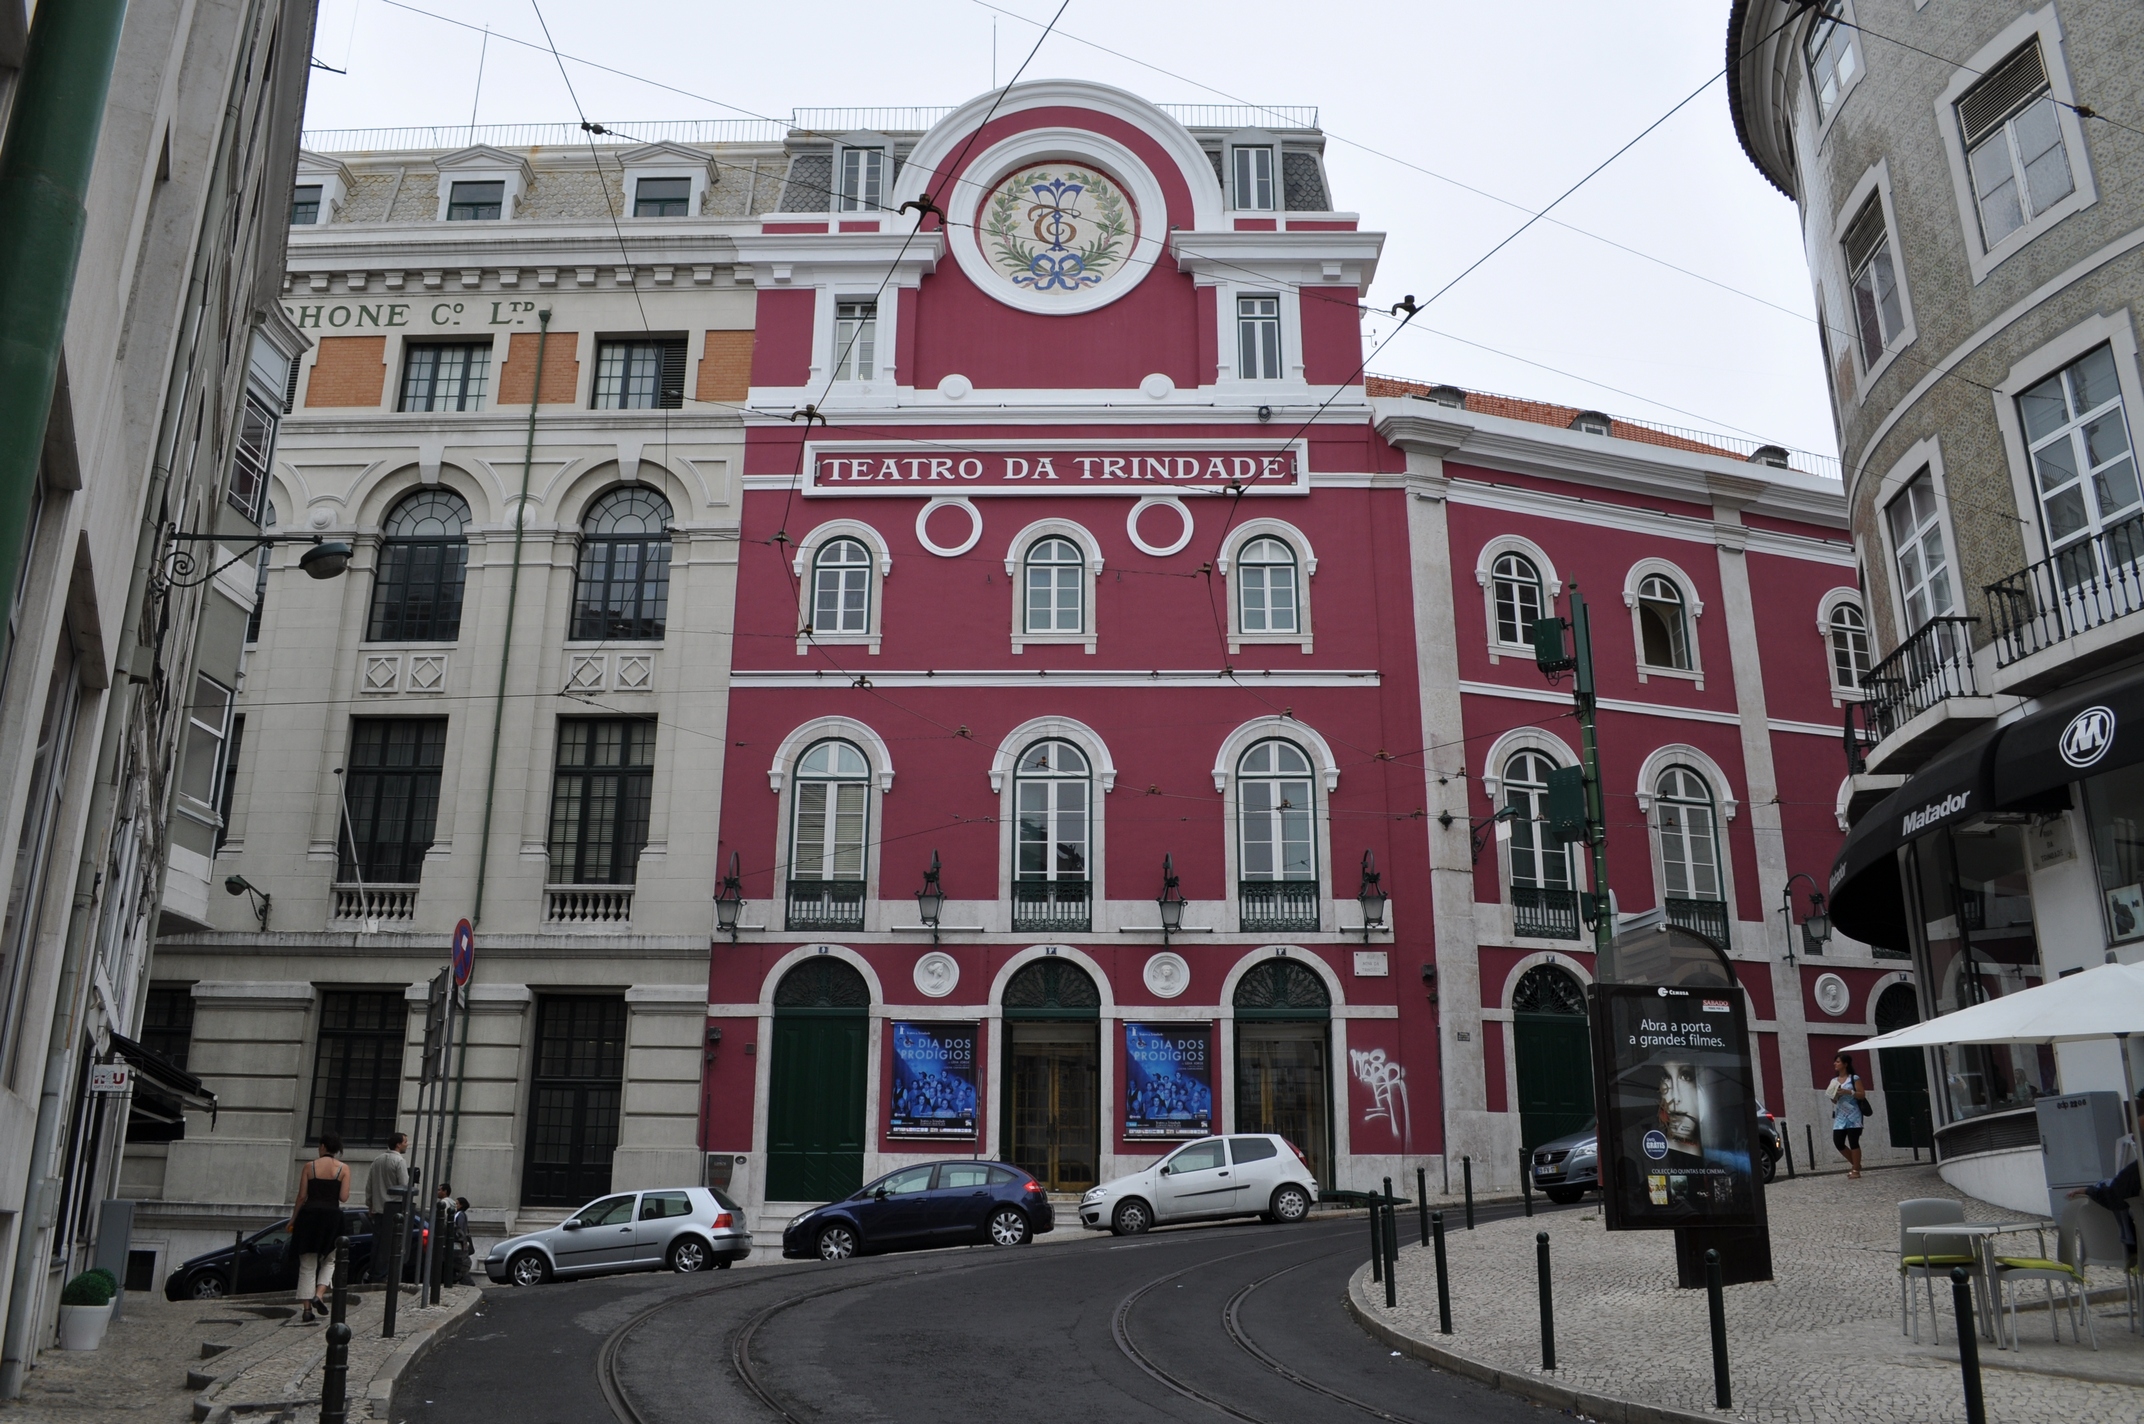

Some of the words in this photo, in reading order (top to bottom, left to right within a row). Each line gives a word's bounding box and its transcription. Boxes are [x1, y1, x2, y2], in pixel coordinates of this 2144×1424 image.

[822, 458, 984, 481] TEATRO
[1003, 457, 1059, 480] DA
[1073, 457, 1287, 480] TRINDADE
[1902, 790, 1971, 836] Matador
[1641, 1018, 1667, 1031] Abra
[1671, 1022, 1678, 1031] a
[1681, 1022, 1712, 1034] porta
[918, 1038, 940, 1048] DIA
[945, 1038, 971, 1049] DOS
[1151, 1040, 1173, 1050] DIA
[1178, 1040, 1204, 1050] DOS
[1629, 1035, 1636, 1044] a
[1640, 1033, 1686, 1048] grandes
[1689, 1033, 1726, 1047] filmes.
